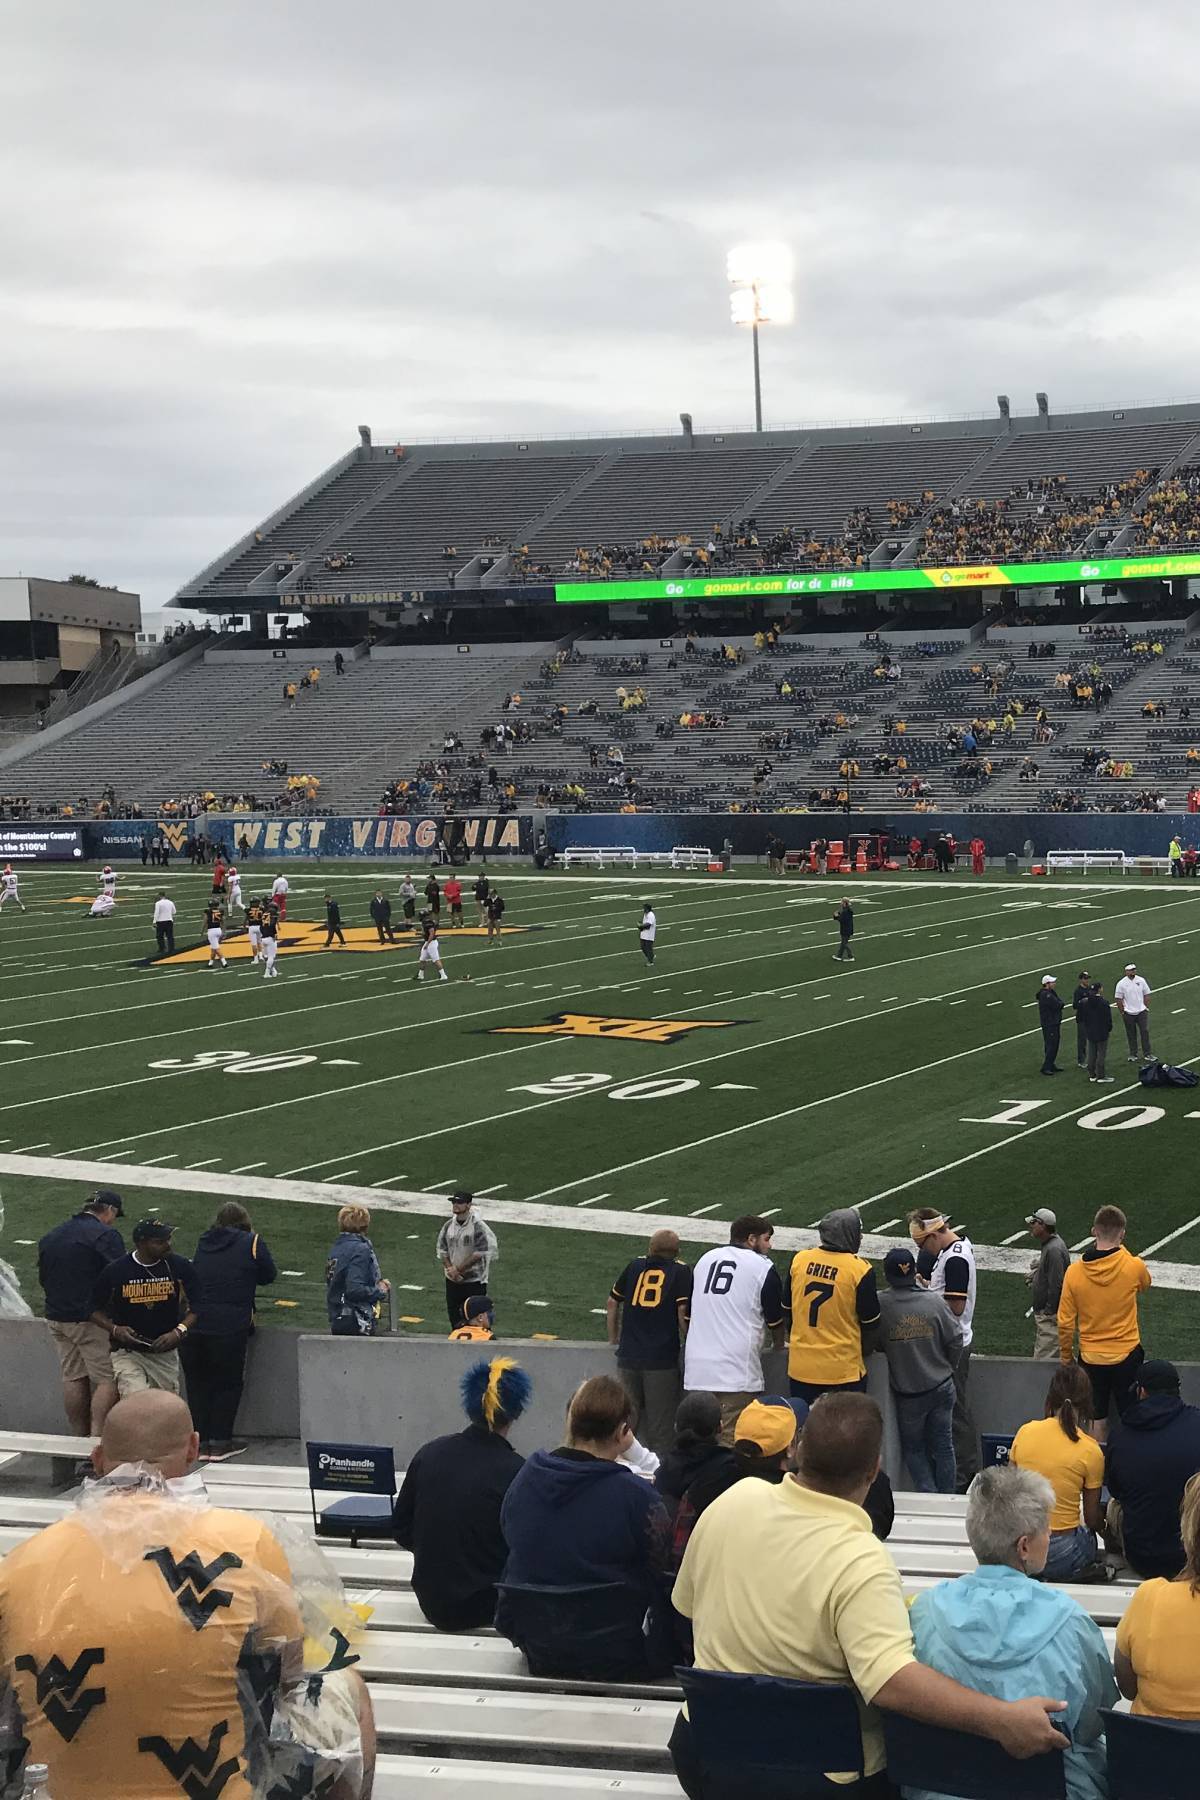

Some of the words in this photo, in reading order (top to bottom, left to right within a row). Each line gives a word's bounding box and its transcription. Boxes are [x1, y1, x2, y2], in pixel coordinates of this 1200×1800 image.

[1080, 564, 1100, 577] Go
[666, 583, 684, 595] Go
[704, 580, 783, 596] gomart.com
[787, 577, 803, 590] for
[103, 835, 142, 845] NISSAN
[233, 821, 327, 849] WEST
[352, 819, 520, 848] VIRGNIA
[148, 1050, 318, 1074] 30
[507, 1072, 701, 1100] 20
[959, 1098, 1167, 1132] 10
[952, 1243, 963, 1254] 8
[704, 1260, 737, 1295] 16
[806, 1262, 839, 1281] GRIER
[122, 1281, 175, 1298] MOUNTAINEERS
[631, 1269, 666, 1309] 18
[803, 1280, 835, 1329] 7
[330, 1457, 375, 1468] Panhandle
